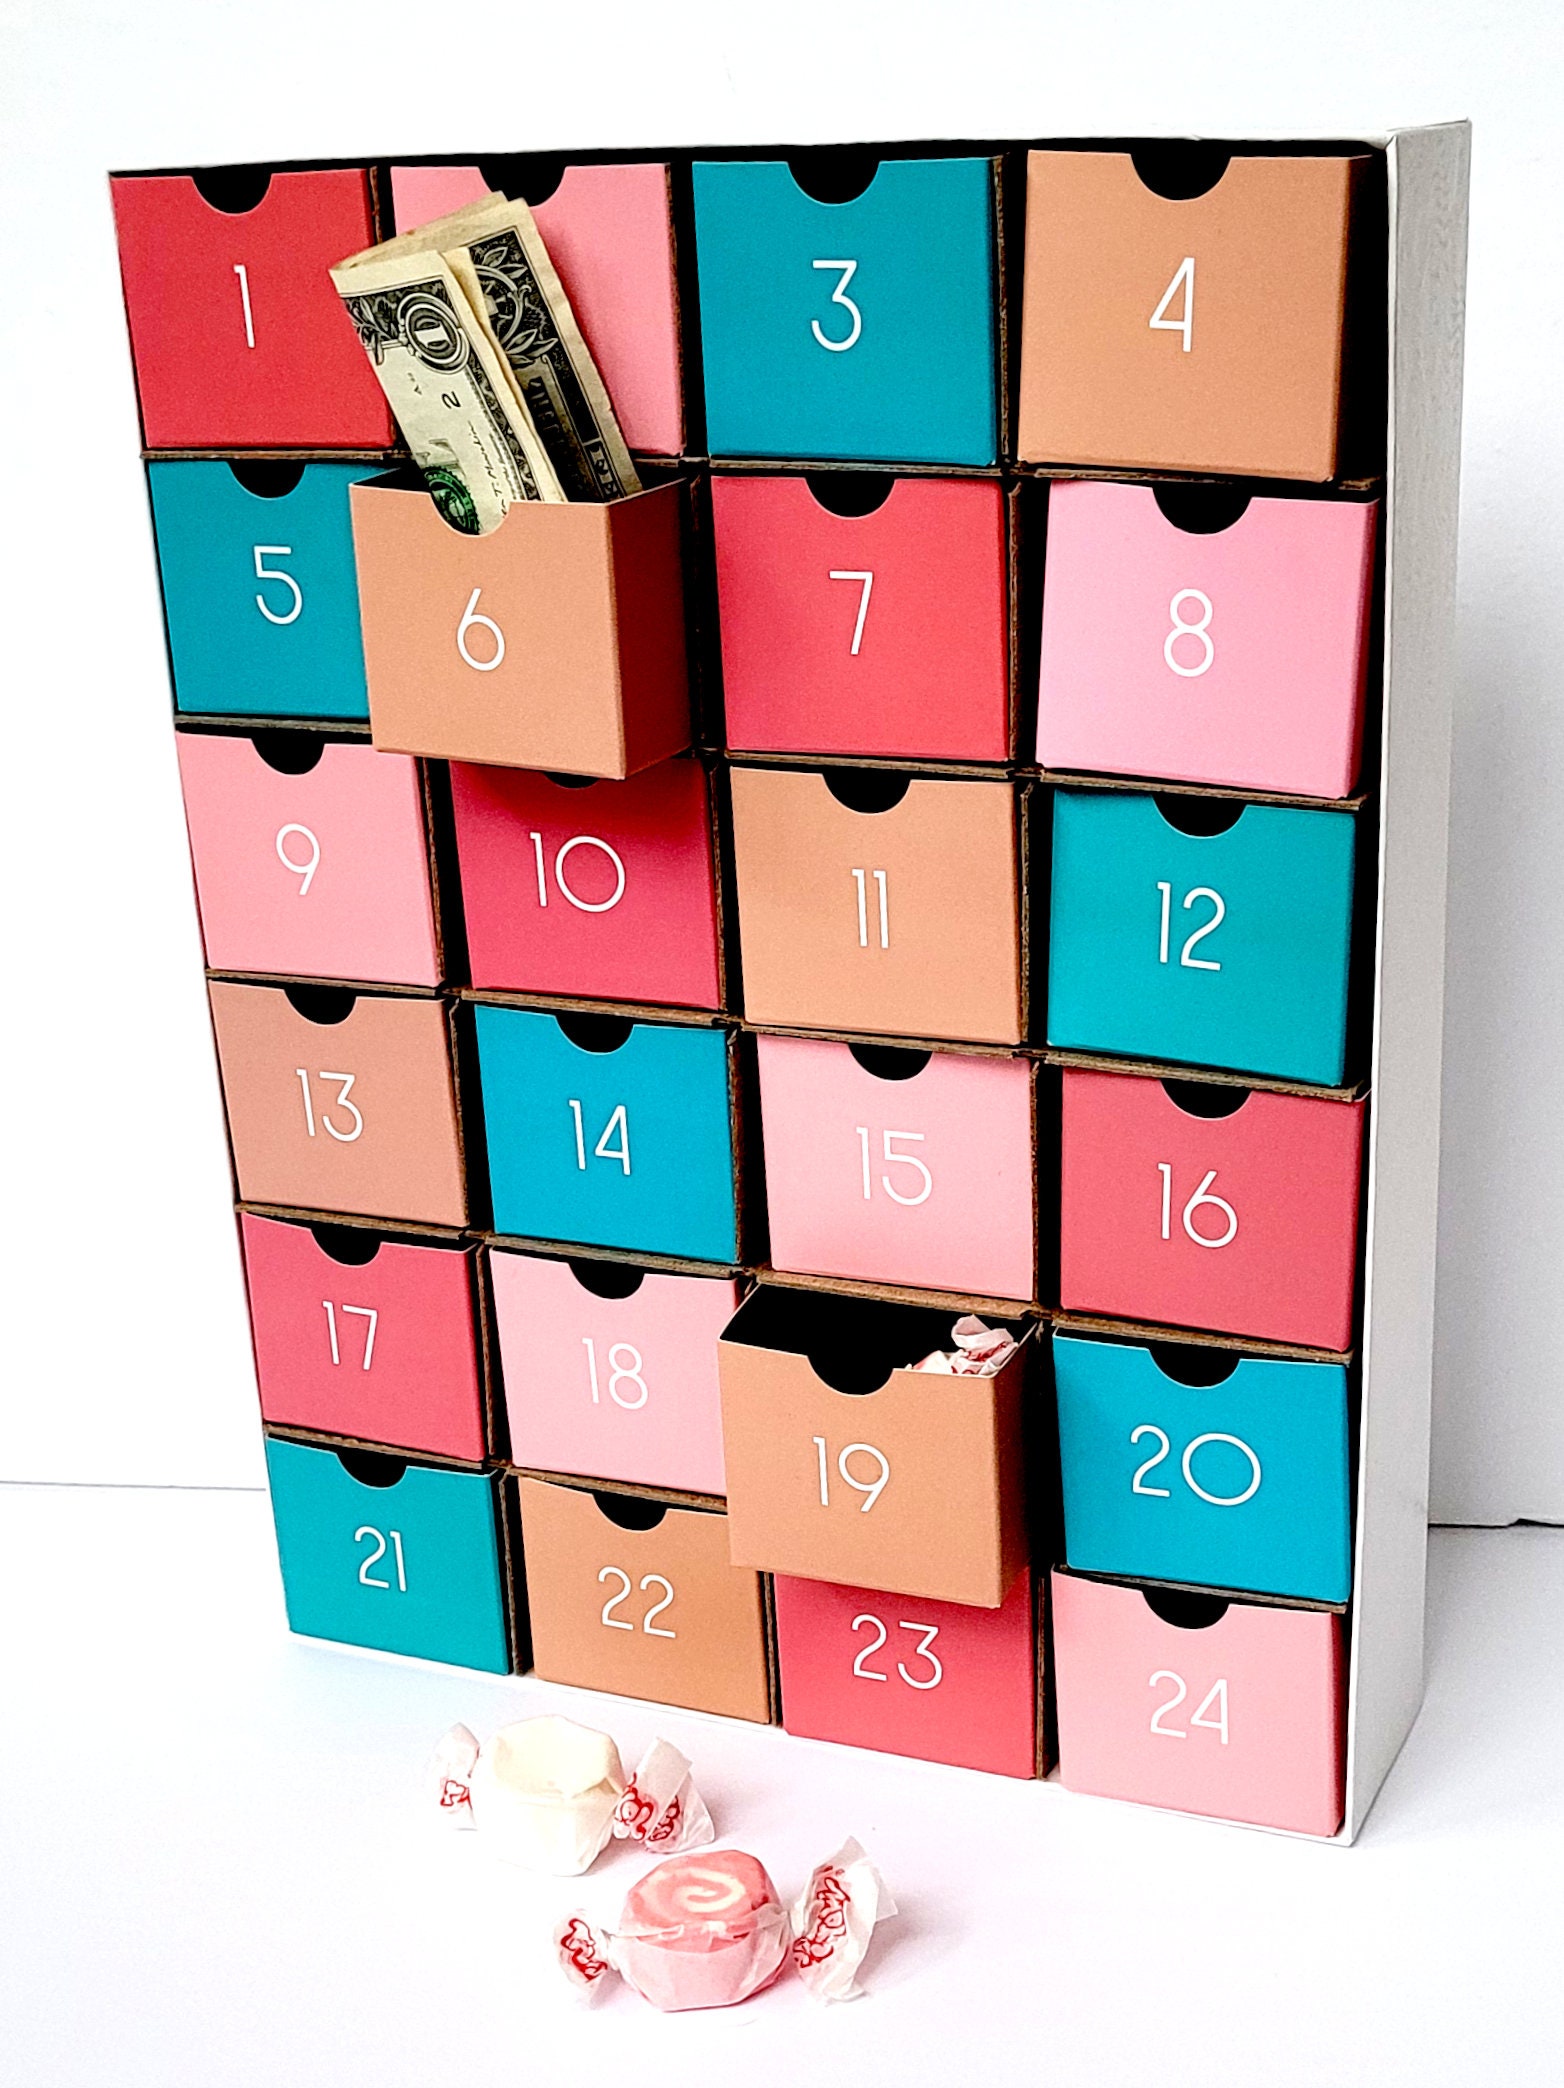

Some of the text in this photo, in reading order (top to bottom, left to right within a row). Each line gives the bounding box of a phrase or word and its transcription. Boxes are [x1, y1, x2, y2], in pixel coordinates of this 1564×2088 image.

[233, 265, 255, 348] 1
[811, 259, 862, 352] 3
[1149, 257, 1195, 352] 4
[441, 391, 462, 410] 2
[254, 545, 303, 625] 5
[829, 570, 873, 655] 7
[457, 588, 505, 671] 6
[1163, 588, 1214, 677] 8
[276, 823, 320, 896] 9
[530, 832, 625, 912] 10
[851, 868, 889, 949] 11
[1157, 881, 1225, 971] 12
[296, 1068, 363, 1142] 13
[569, 1099, 631, 1176] 14
[856, 1126, 932, 1206] 15
[1158, 1162, 1238, 1248] 16
[322, 1300, 378, 1370] 17
[582, 1337, 648, 1410] 18
[813, 1436, 890, 1512] 19
[1130, 1424, 1261, 1506] 20
[354, 1526, 407, 1592] 21
[598, 1566, 676, 1638] 22
[852, 1614, 942, 1689] 23
[1149, 1670, 1229, 1745] 24
